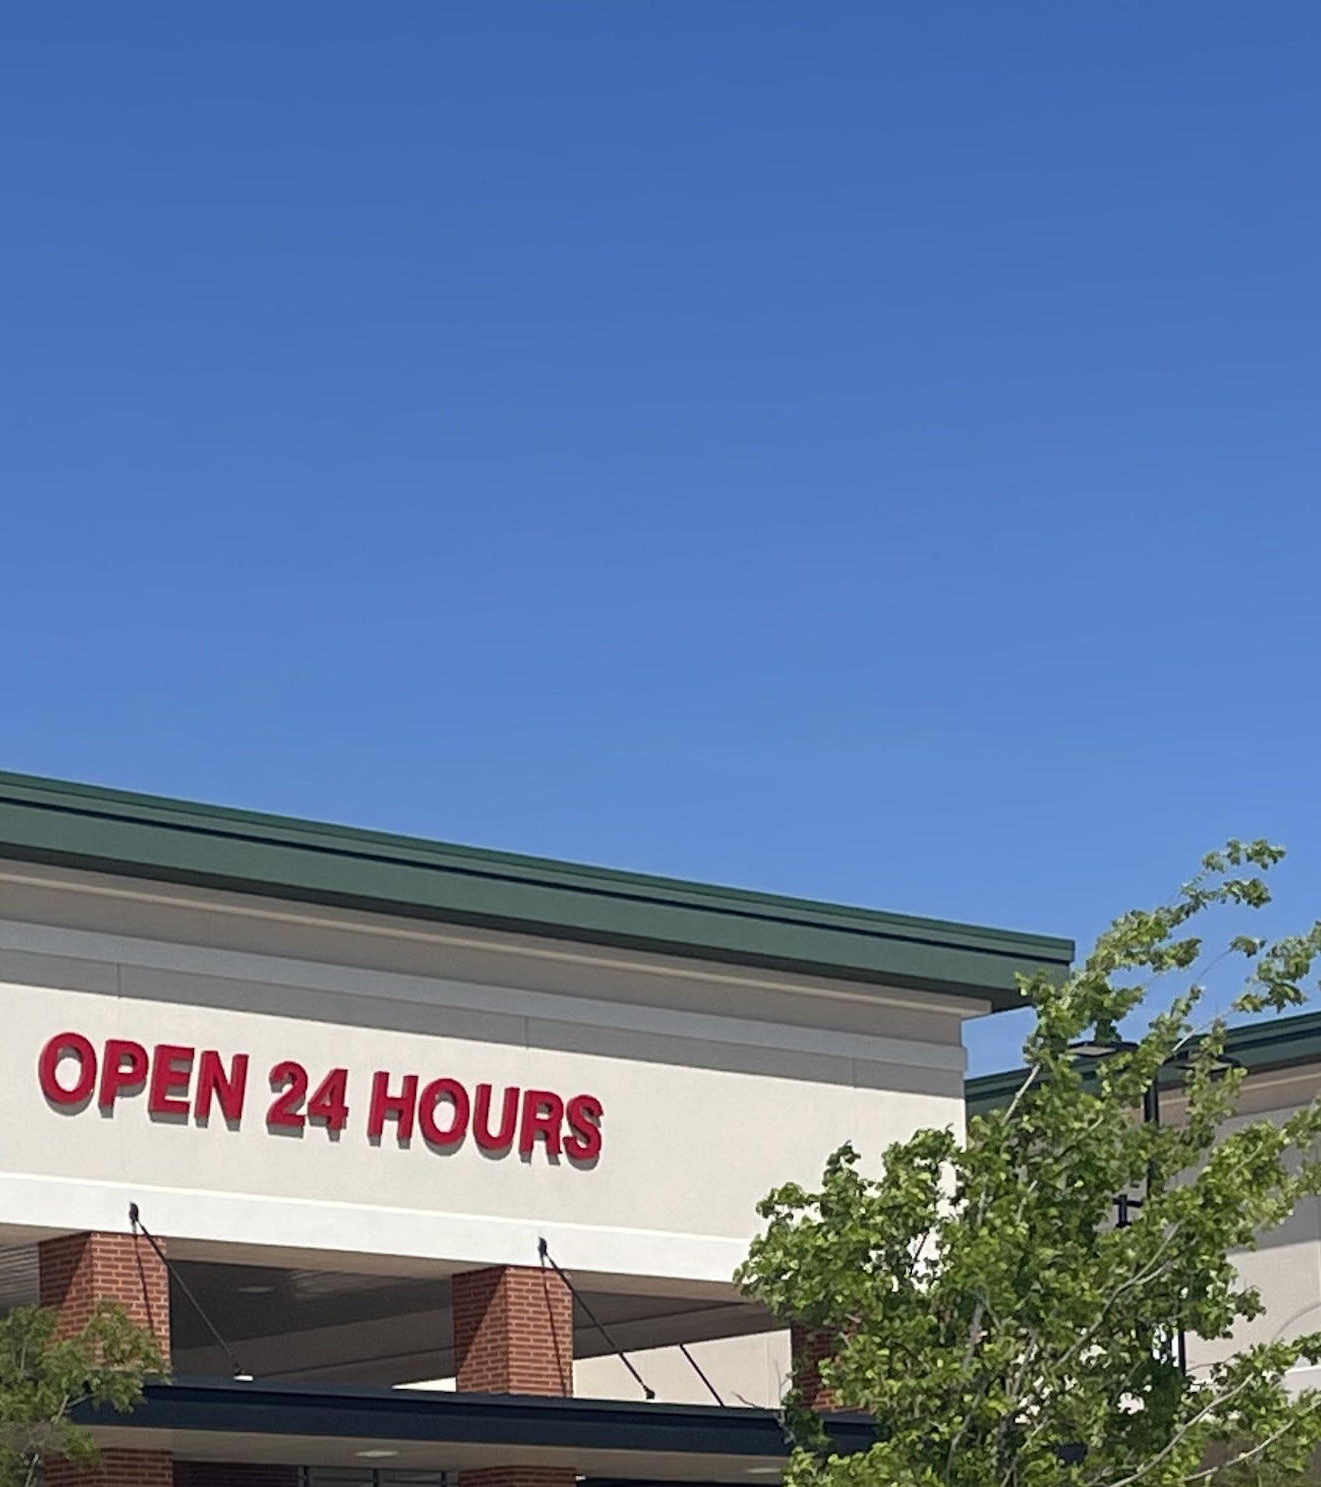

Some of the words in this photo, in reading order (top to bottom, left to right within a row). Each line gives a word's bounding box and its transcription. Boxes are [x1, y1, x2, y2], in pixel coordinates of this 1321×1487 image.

[38, 1032, 249, 1124] OPEN
[266, 1061, 349, 1134] 24
[367, 1071, 605, 1162] HOURS
